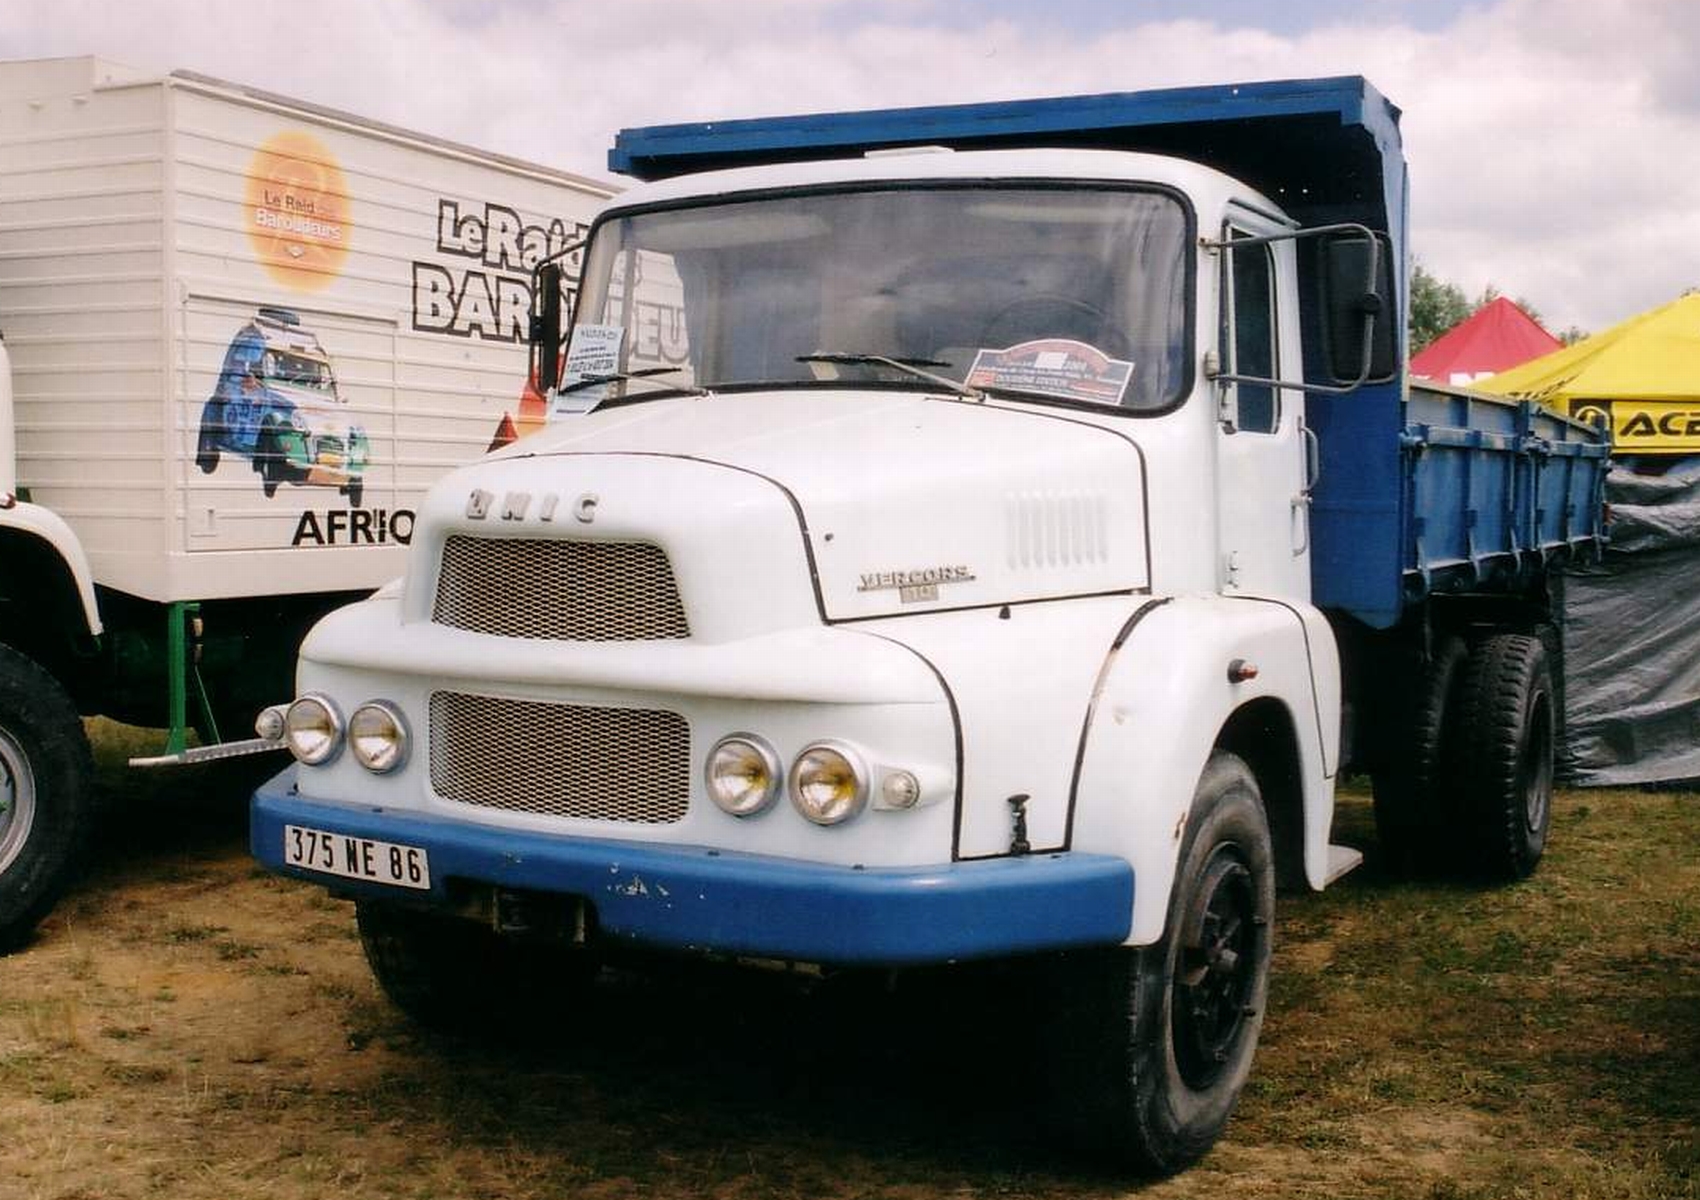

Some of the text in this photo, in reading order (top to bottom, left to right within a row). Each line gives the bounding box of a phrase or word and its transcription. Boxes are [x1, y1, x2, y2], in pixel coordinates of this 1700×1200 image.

[264, 189, 315, 214] Le Raid
[859, 565, 970, 589] VERCORS
[292, 828, 421, 883] 375 NE 86
